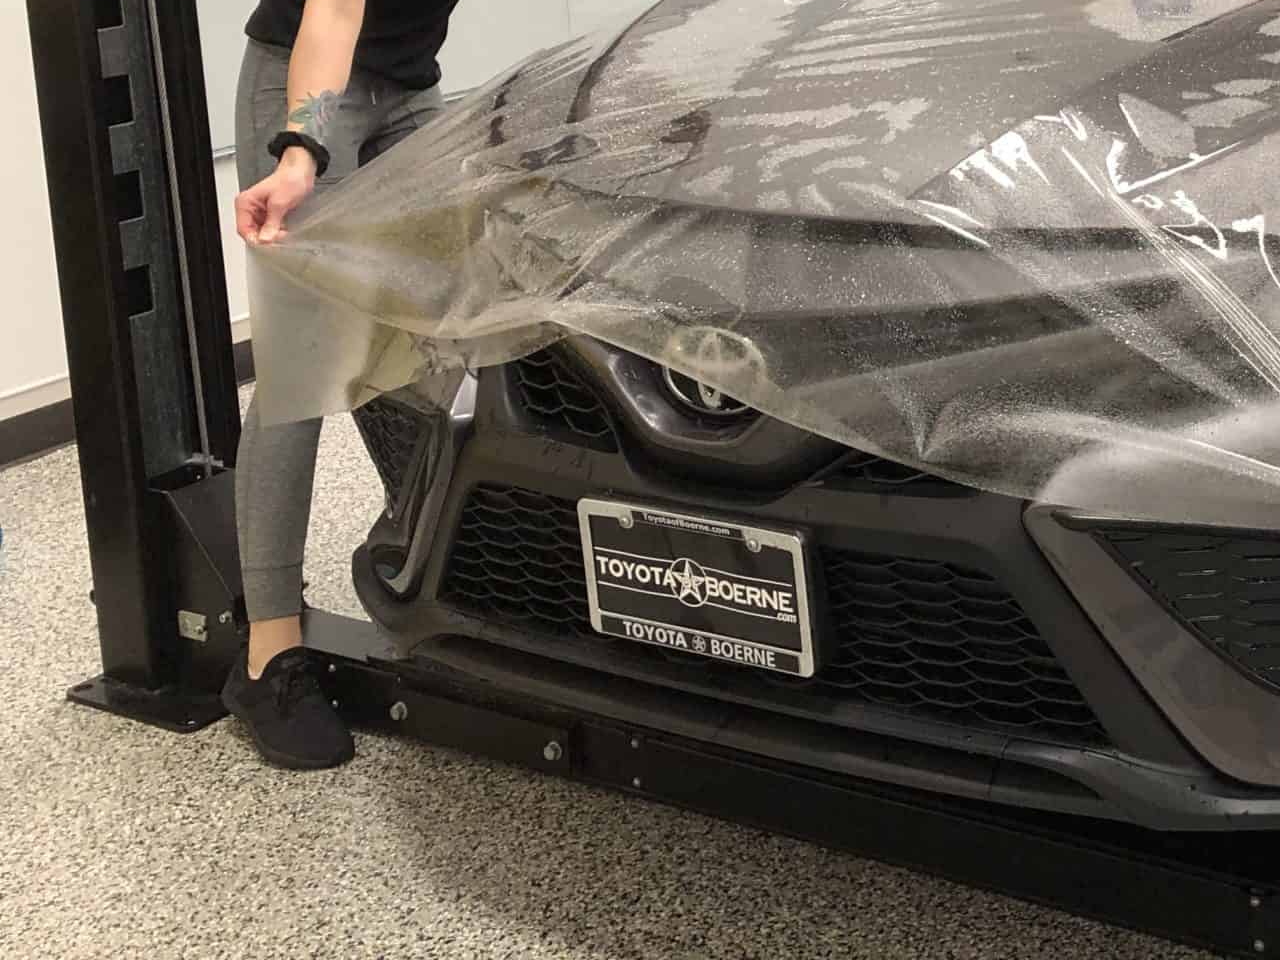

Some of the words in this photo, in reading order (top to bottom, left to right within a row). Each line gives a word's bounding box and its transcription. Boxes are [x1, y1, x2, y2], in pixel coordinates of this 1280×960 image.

[596, 555, 677, 587] TOYOTA
[704, 576, 793, 612] BOERNE
[622, 620, 688, 649] TOYOTA
[710, 638, 777, 668] BOERNE
